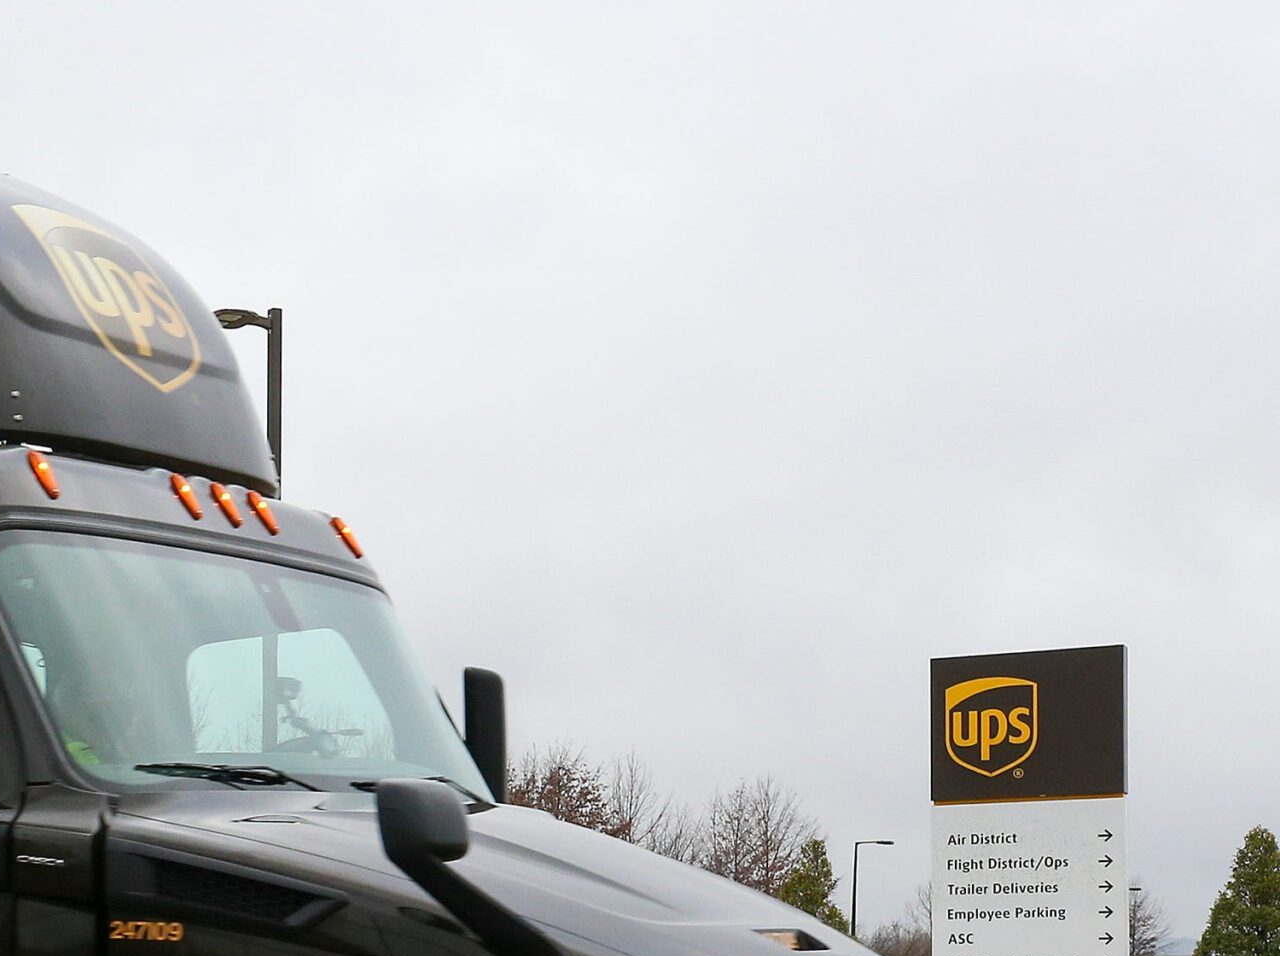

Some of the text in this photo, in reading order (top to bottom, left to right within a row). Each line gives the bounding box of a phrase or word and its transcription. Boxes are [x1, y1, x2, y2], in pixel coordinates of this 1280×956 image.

[49, 244, 187, 357] ups
[952, 706, 1031, 761] ups
[947, 832, 1017, 846] Air District
[947, 856, 1069, 873] Flight District/Ops
[947, 882, 1059, 895] Trailer Deliveries
[947, 906, 1066, 922] Employee Parking
[109, 920, 184, 941] 247109
[948, 933, 974, 945] ASC
